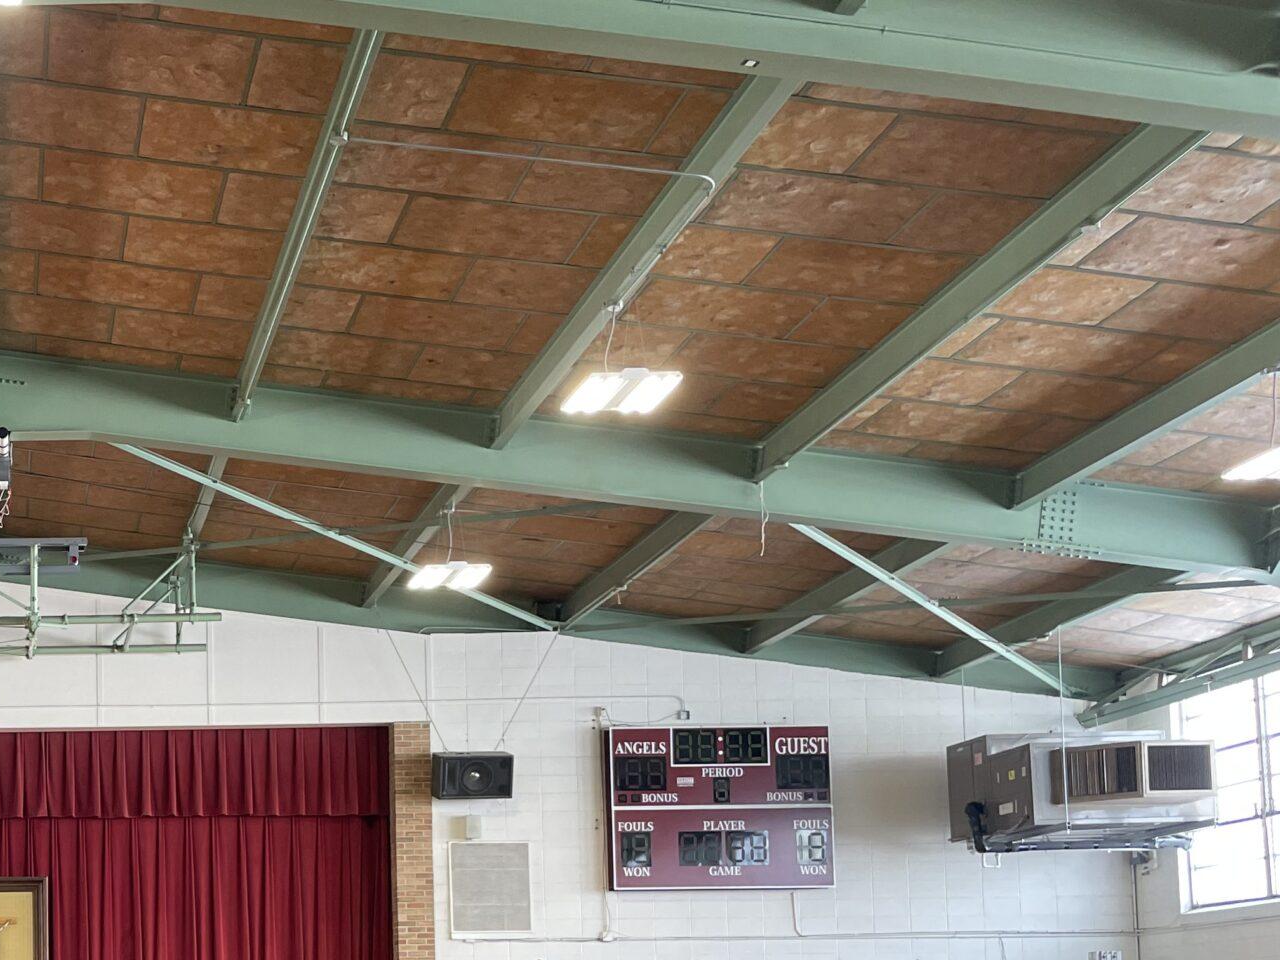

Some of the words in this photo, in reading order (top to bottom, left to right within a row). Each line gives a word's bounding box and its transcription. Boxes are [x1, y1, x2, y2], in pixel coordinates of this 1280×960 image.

[615, 741, 666, 755] ANGELS
[775, 736, 828, 755] GUEST
[701, 767, 744, 778] PERIOD
[641, 793, 678, 803] BONUS
[766, 791, 803, 802] BONUS
[618, 821, 654, 832] FOULS
[703, 820, 745, 831] PLAYER
[793, 819, 829, 830] FOULS
[623, 866, 650, 877] WON
[708, 865, 742, 877] GAME
[800, 865, 827, 876] WON
